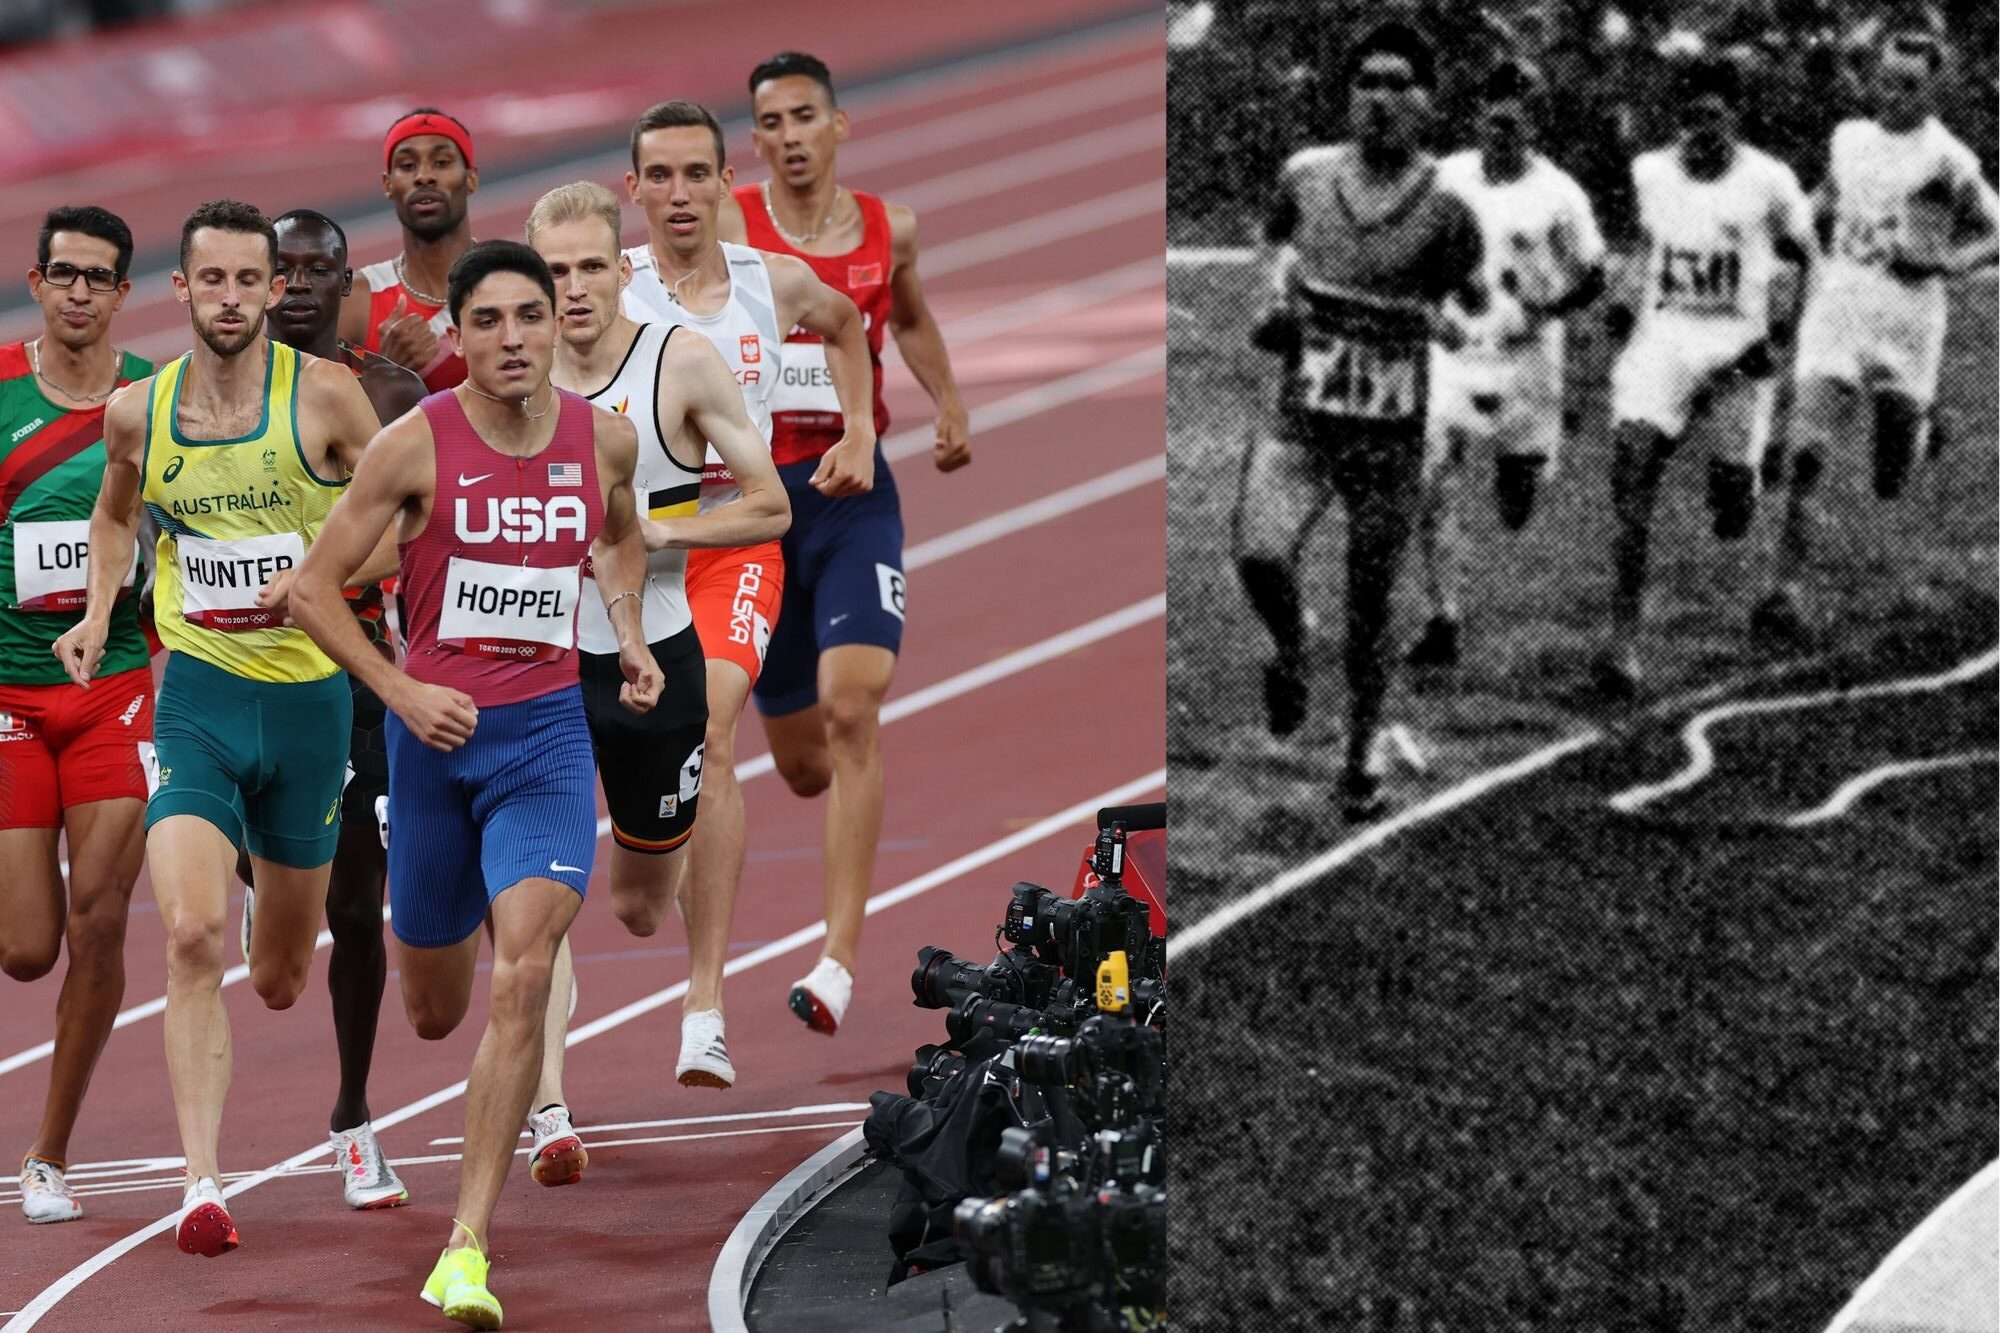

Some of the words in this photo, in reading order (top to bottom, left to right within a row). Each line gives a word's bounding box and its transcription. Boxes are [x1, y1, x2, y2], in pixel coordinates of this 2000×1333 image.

[173, 490, 283, 516] AUSTRALIA
[454, 495, 587, 544] USA
[38, 542, 88, 571] LOP
[57, 597, 78, 605] TOKYO
[456, 581, 566, 618] HOPPEL
[213, 616, 233, 624] TOKYO
[233, 616, 249, 624] 2020
[479, 644, 500, 653] TOKYO
[500, 646, 517, 654] 2020
